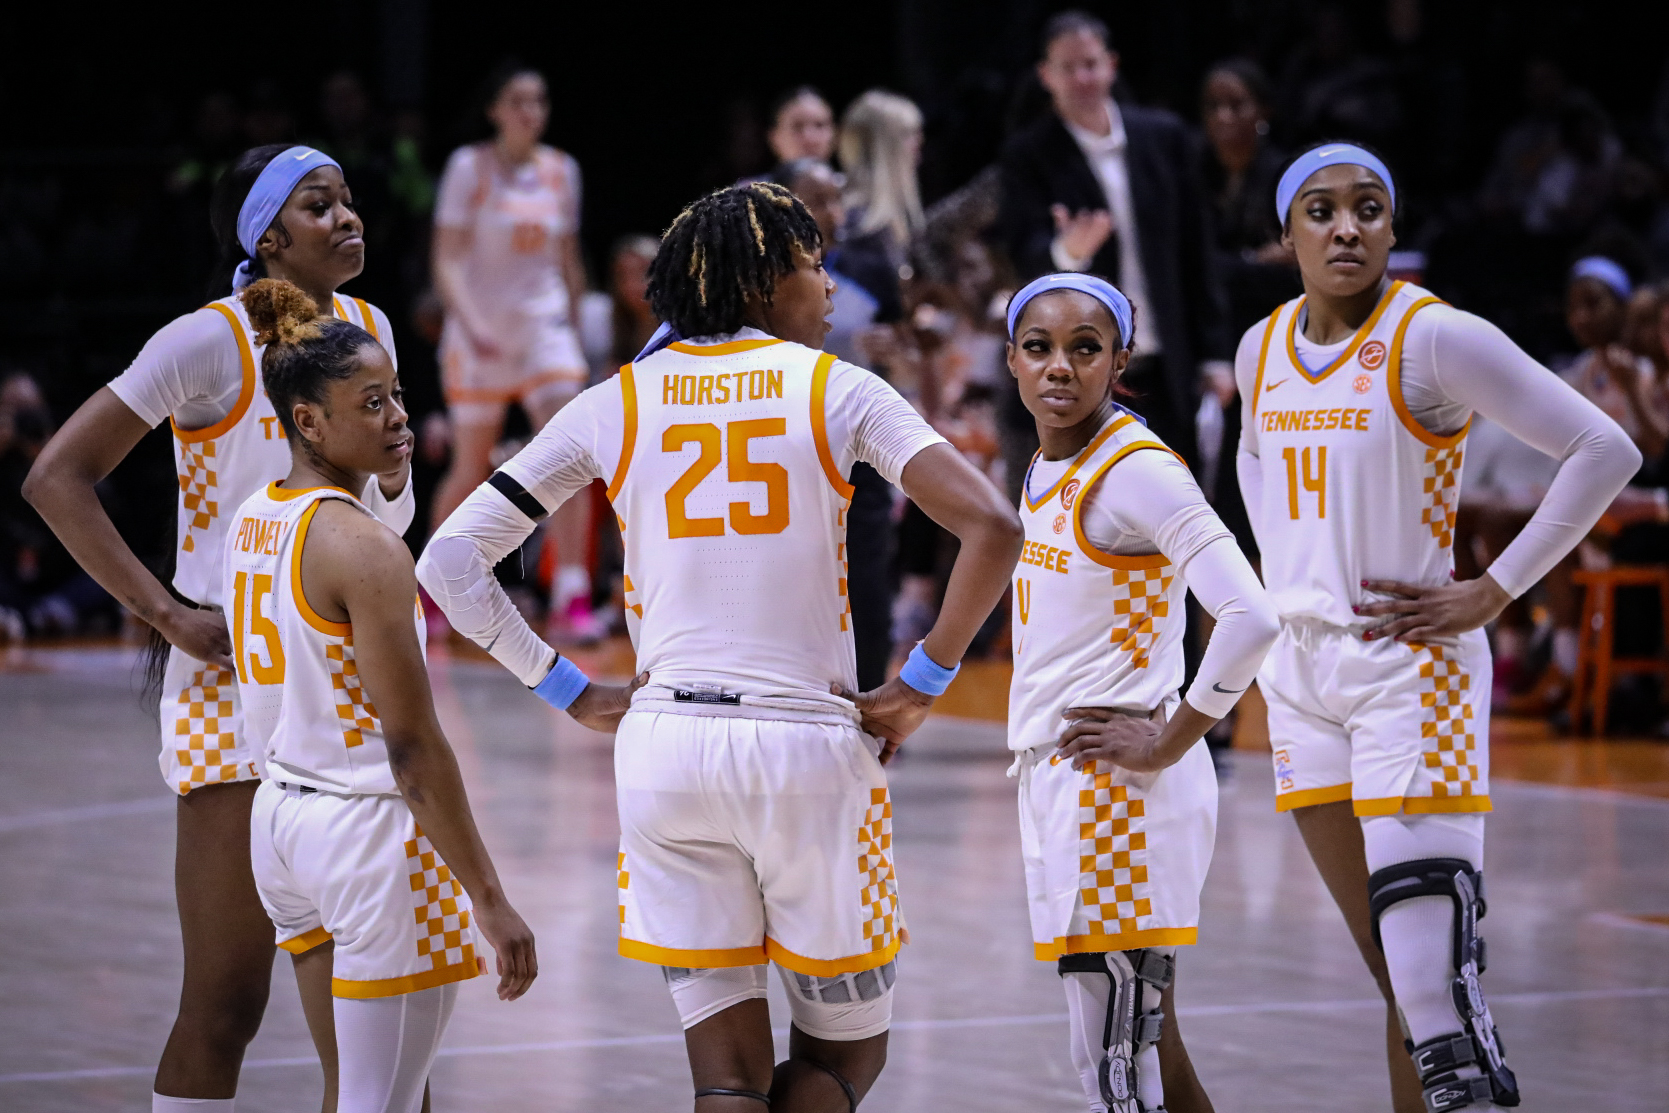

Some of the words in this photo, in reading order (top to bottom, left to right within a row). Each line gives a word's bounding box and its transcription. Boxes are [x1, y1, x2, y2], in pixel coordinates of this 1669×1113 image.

[662, 369, 784, 406] HORSTON
[1261, 408, 1373, 433] TENNESSEE
[661, 417, 790, 539] 25
[1282, 446, 1328, 520] 14
[1018, 539, 1073, 575] ESSEE
[233, 571, 287, 685] 15
[1127, 982, 1136, 1017] TITANIUM
